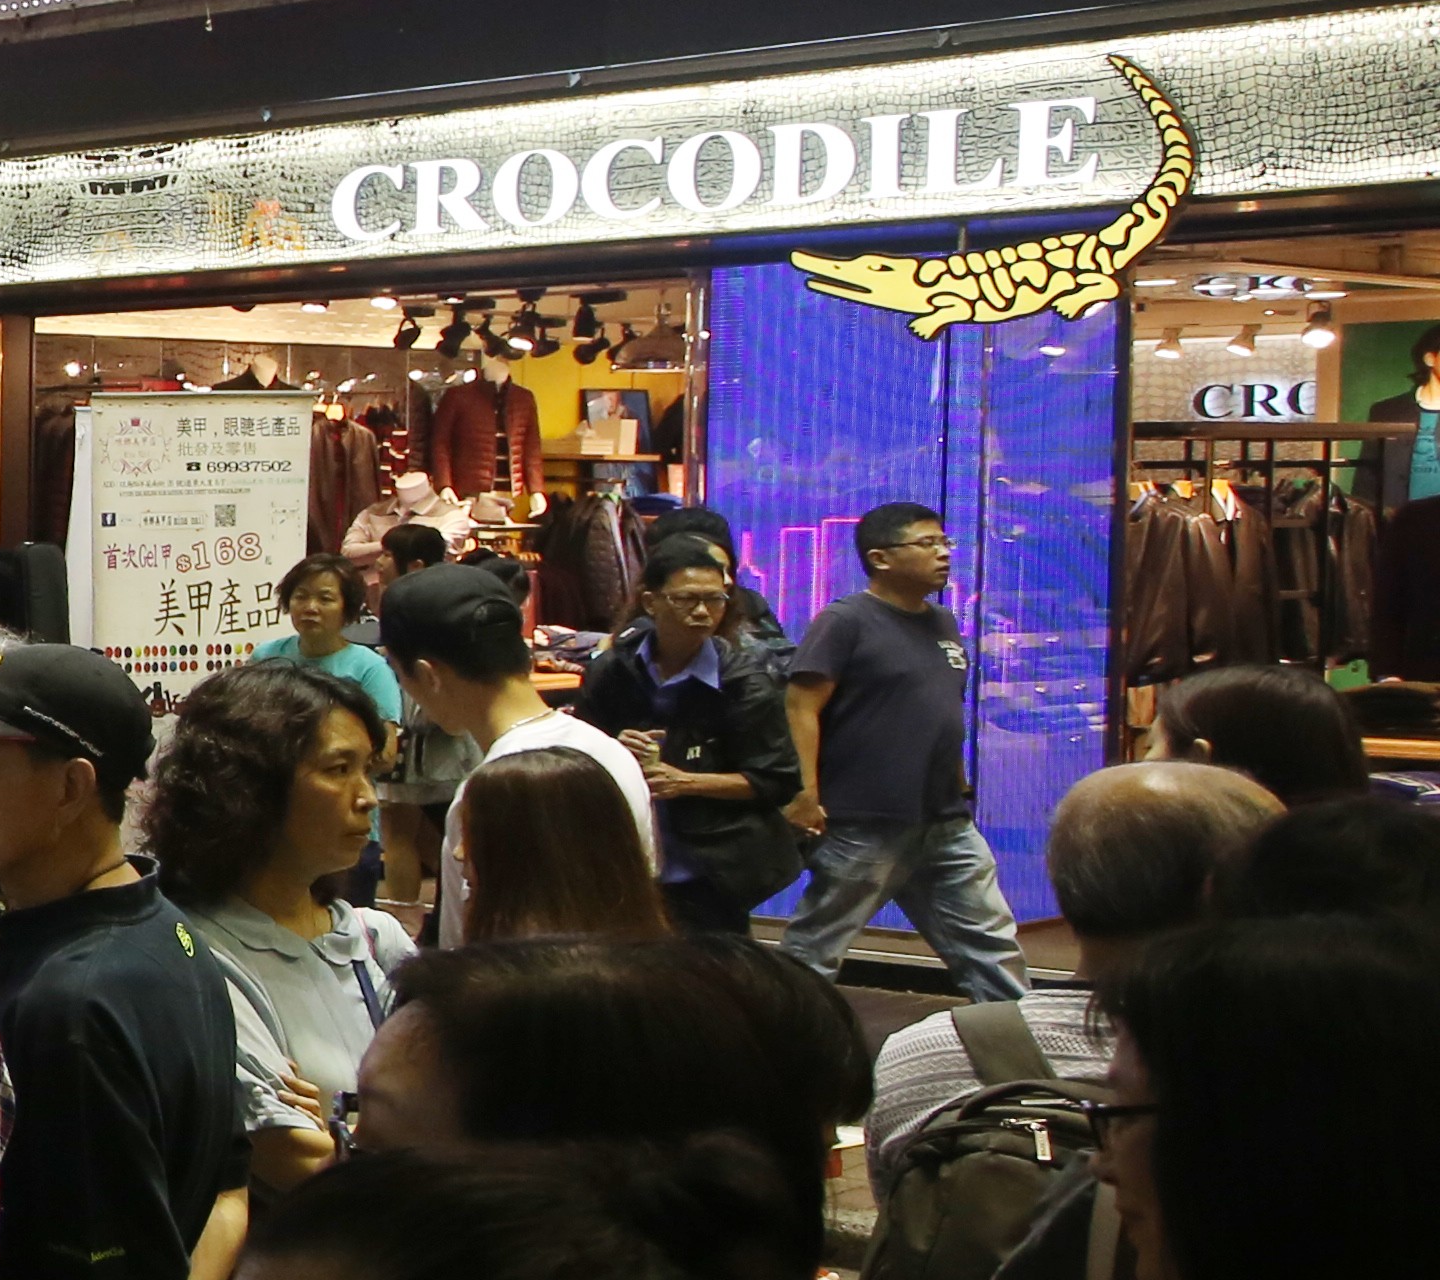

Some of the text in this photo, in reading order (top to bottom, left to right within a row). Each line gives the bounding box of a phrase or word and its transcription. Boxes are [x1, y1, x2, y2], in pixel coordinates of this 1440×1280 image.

[330, 96, 1097, 244] CROCODILE
[206, 461, 292, 472] 69937502
[176, 533, 262, 572] $168
[154, 578, 281, 637] 美甲產品
